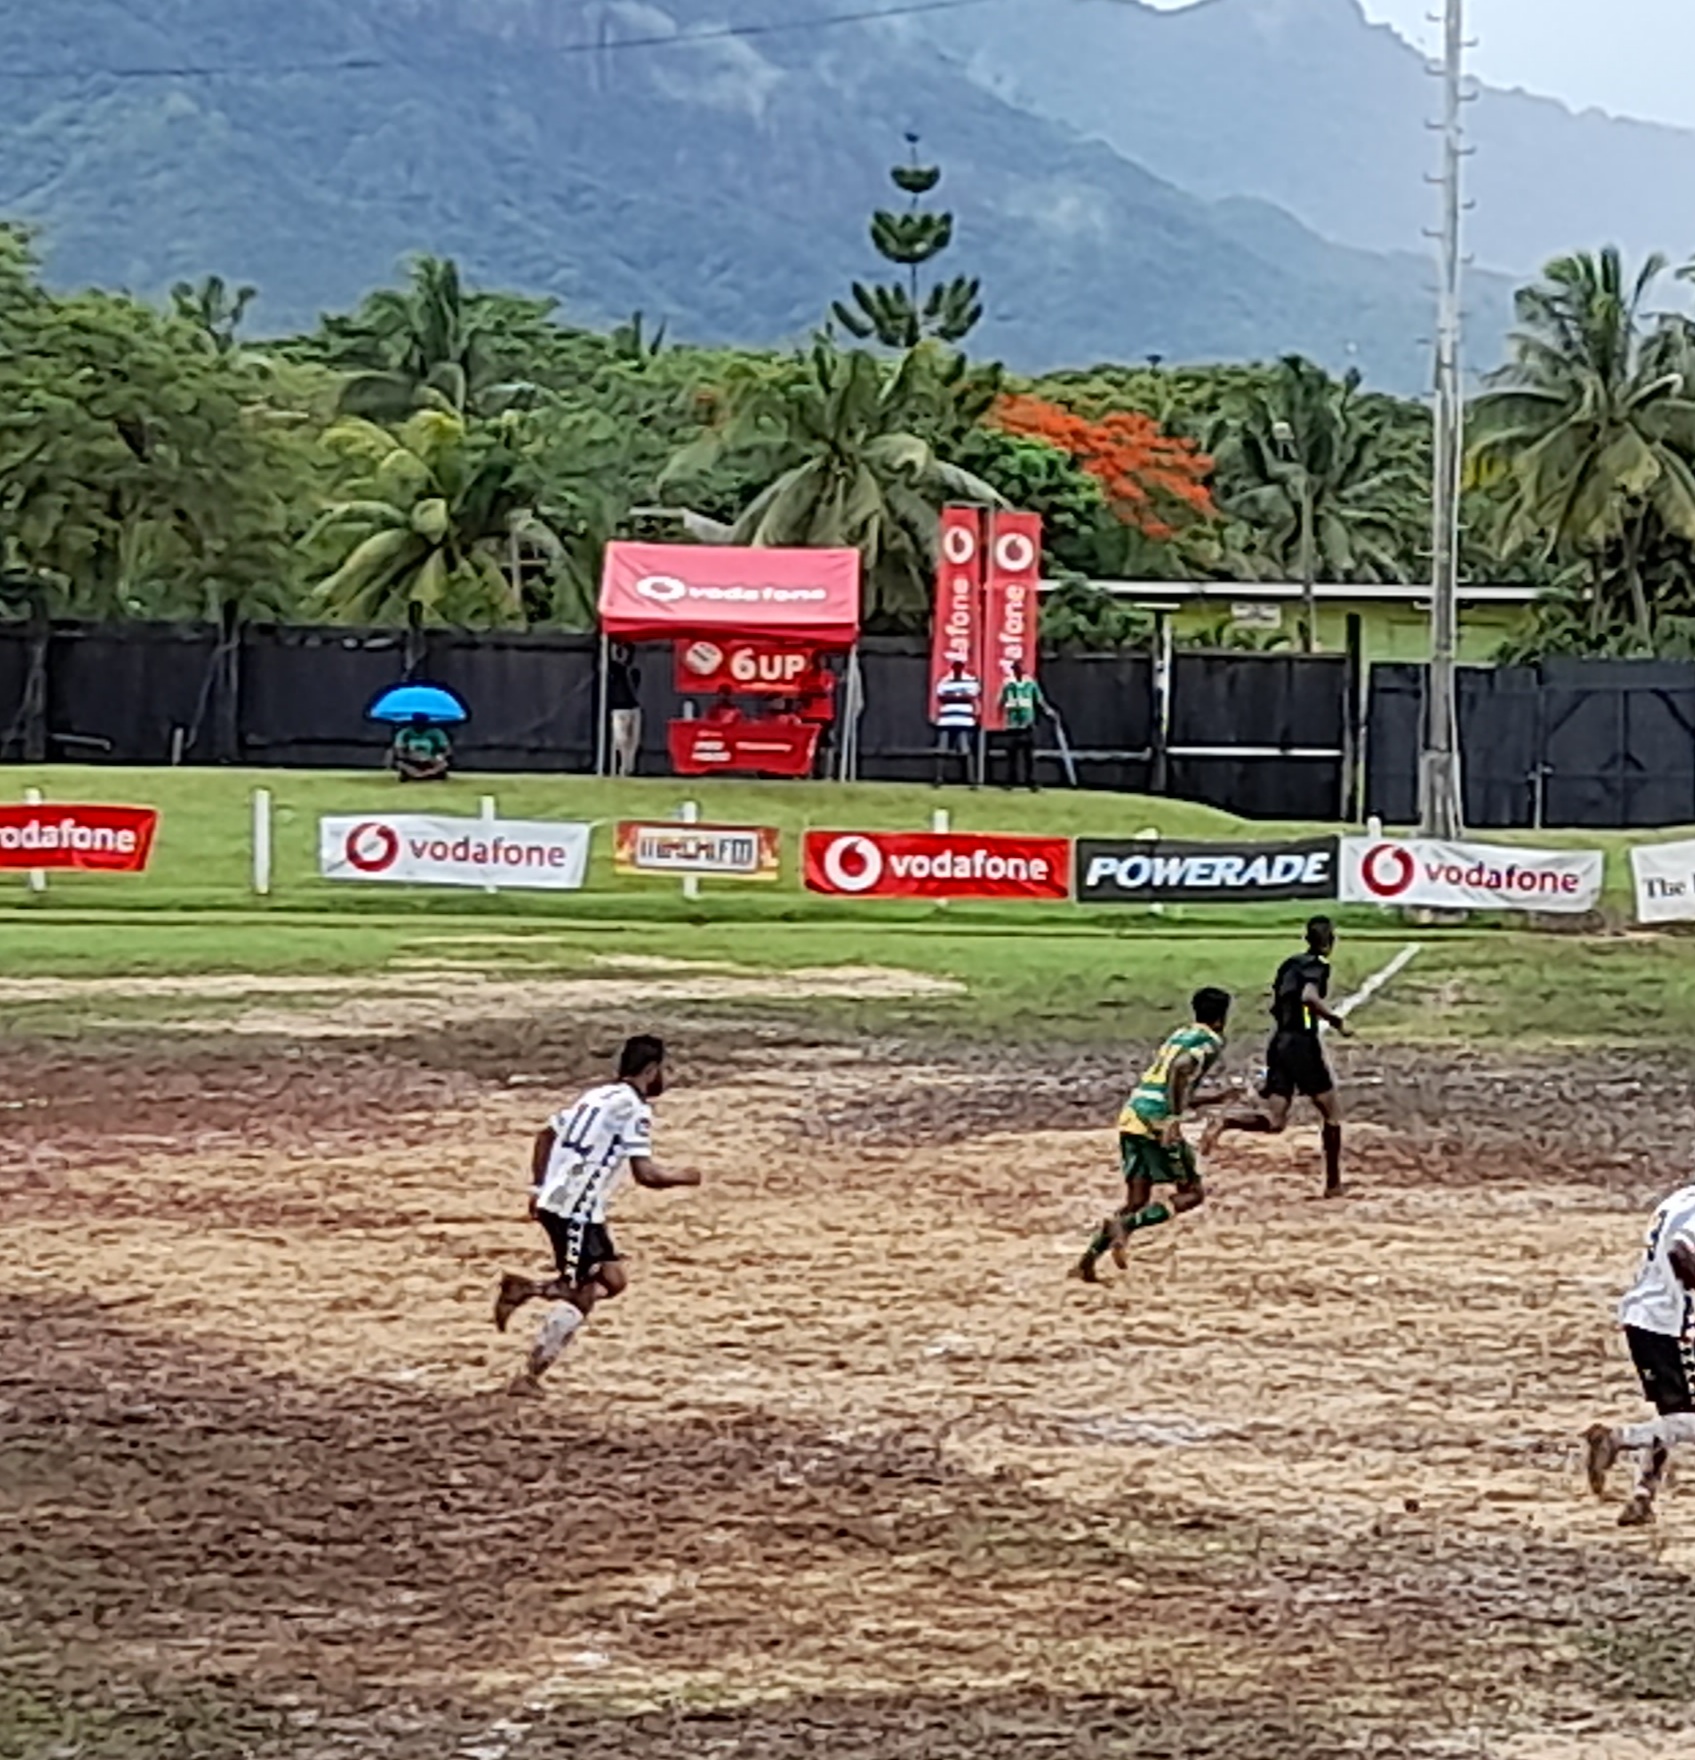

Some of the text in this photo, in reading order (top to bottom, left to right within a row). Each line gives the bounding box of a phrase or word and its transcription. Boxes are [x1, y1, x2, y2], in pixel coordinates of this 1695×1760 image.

[730, 647, 805, 681] 6UP
[0, 817, 136, 853] odafone
[408, 834, 566, 867] vodafone
[889, 849, 1049, 881] vodafone
[1086, 852, 1330, 888] POWERADE
[1425, 861, 1579, 893] vodafone
[1643, 876, 1686, 898] The
[561, 1102, 600, 1156] 11
